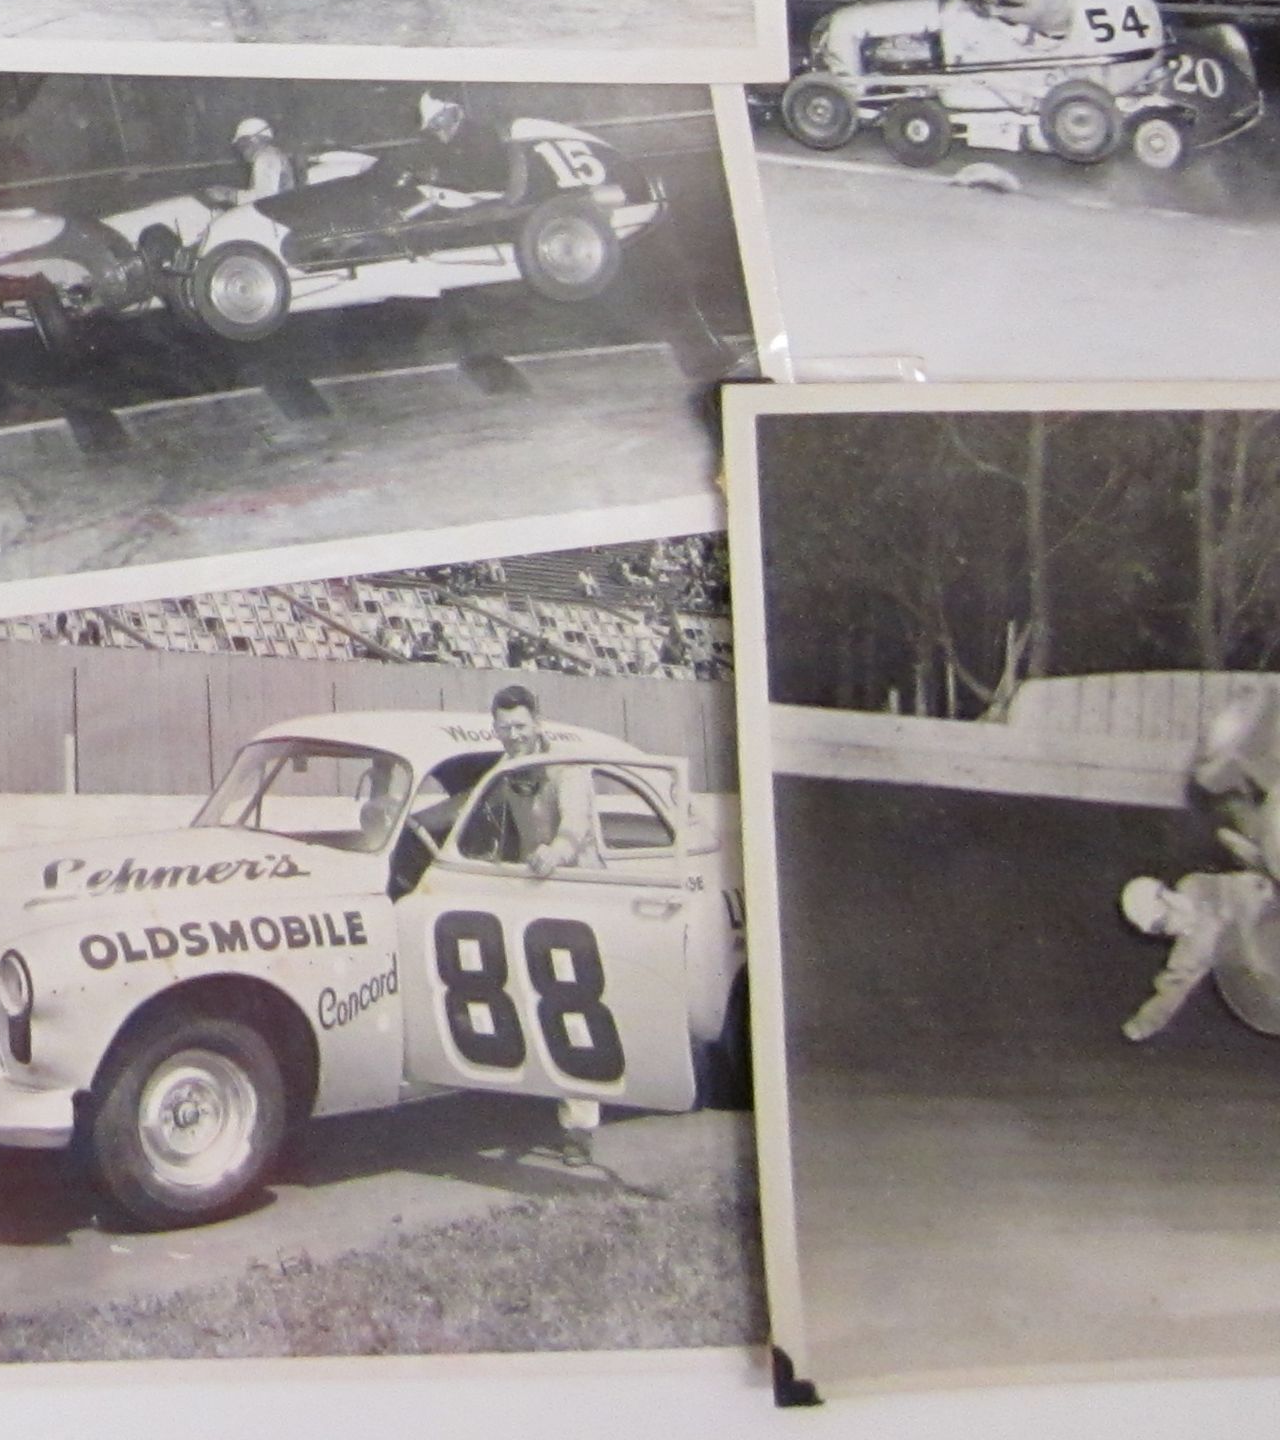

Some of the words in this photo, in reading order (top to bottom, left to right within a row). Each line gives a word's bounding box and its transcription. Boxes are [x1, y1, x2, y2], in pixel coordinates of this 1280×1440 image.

[1085, 5, 1151, 44] 54
[1169, 54, 1225, 99] 20
[533, 139, 607, 188] 15
[24, 853, 311, 911] Lehmer's
[79, 910, 369, 971] OLDSMOBILE
[318, 952, 400, 1031] Concord
[432, 908, 627, 1084] 88
